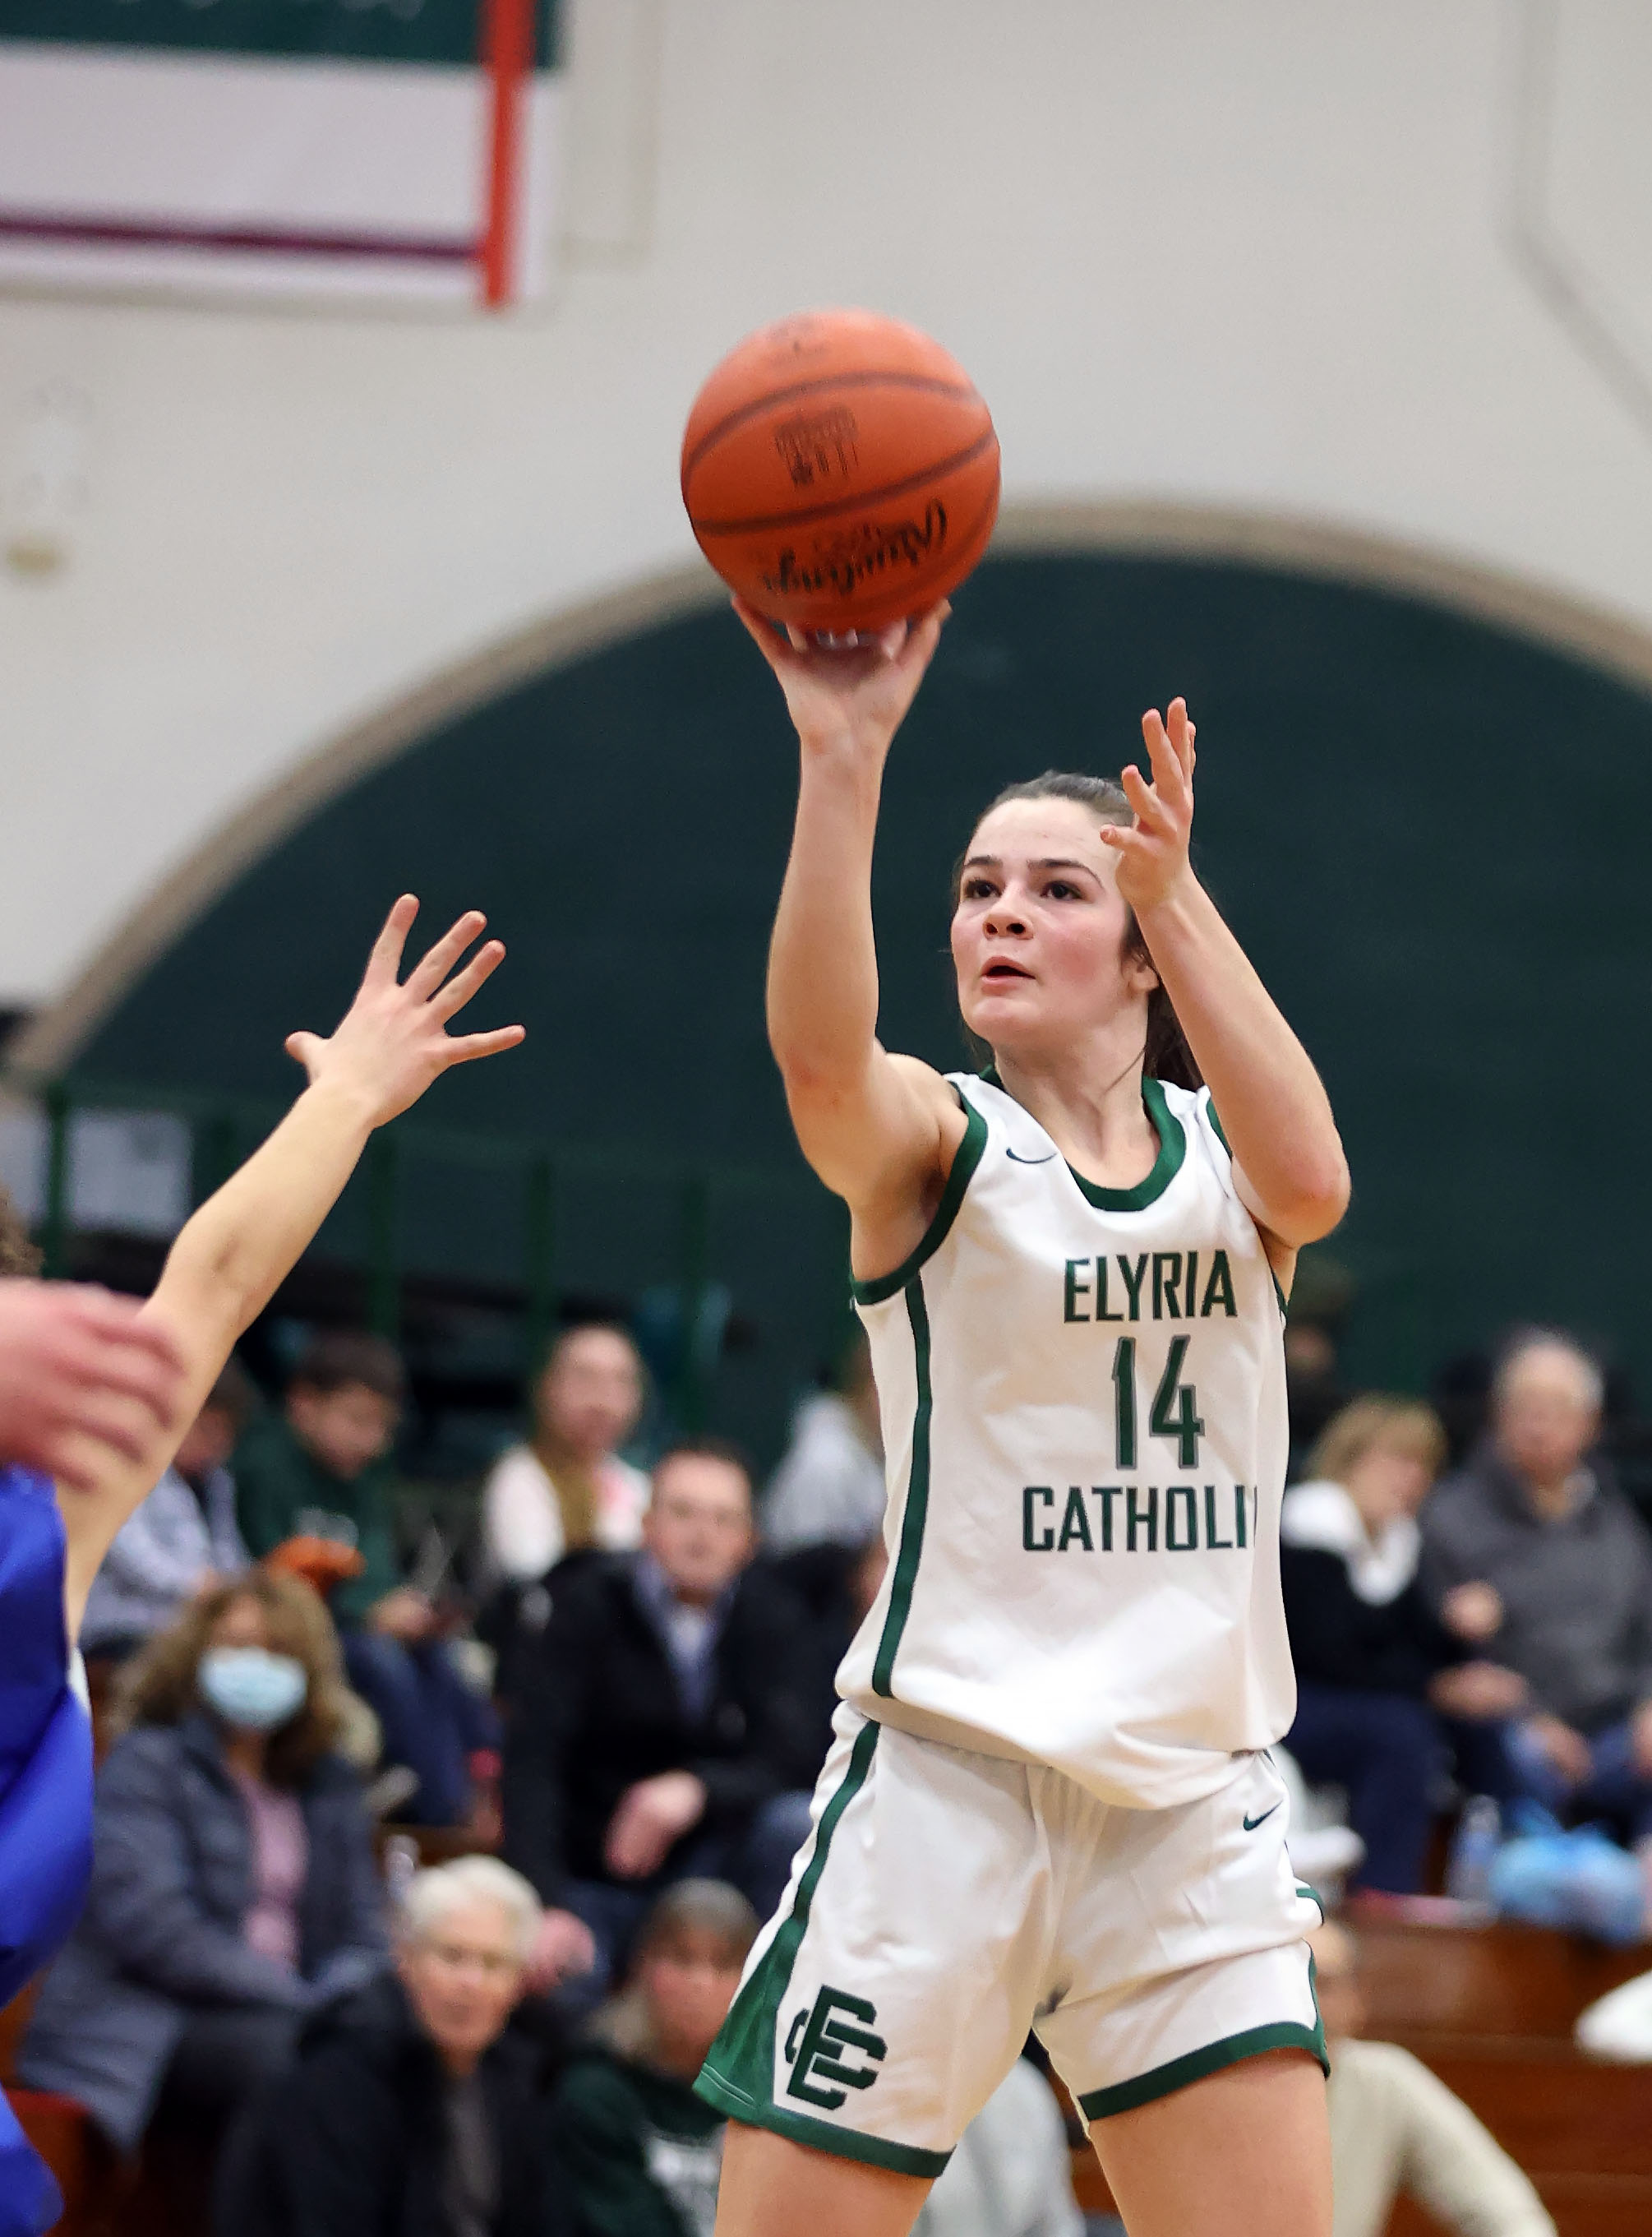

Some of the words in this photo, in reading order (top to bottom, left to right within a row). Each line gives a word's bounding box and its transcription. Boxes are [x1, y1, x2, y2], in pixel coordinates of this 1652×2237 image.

[1064, 1249, 1238, 1324] ELYRIA
[1111, 1334, 1206, 1470] 14
[1022, 1485, 1257, 1552] CATHOLI
